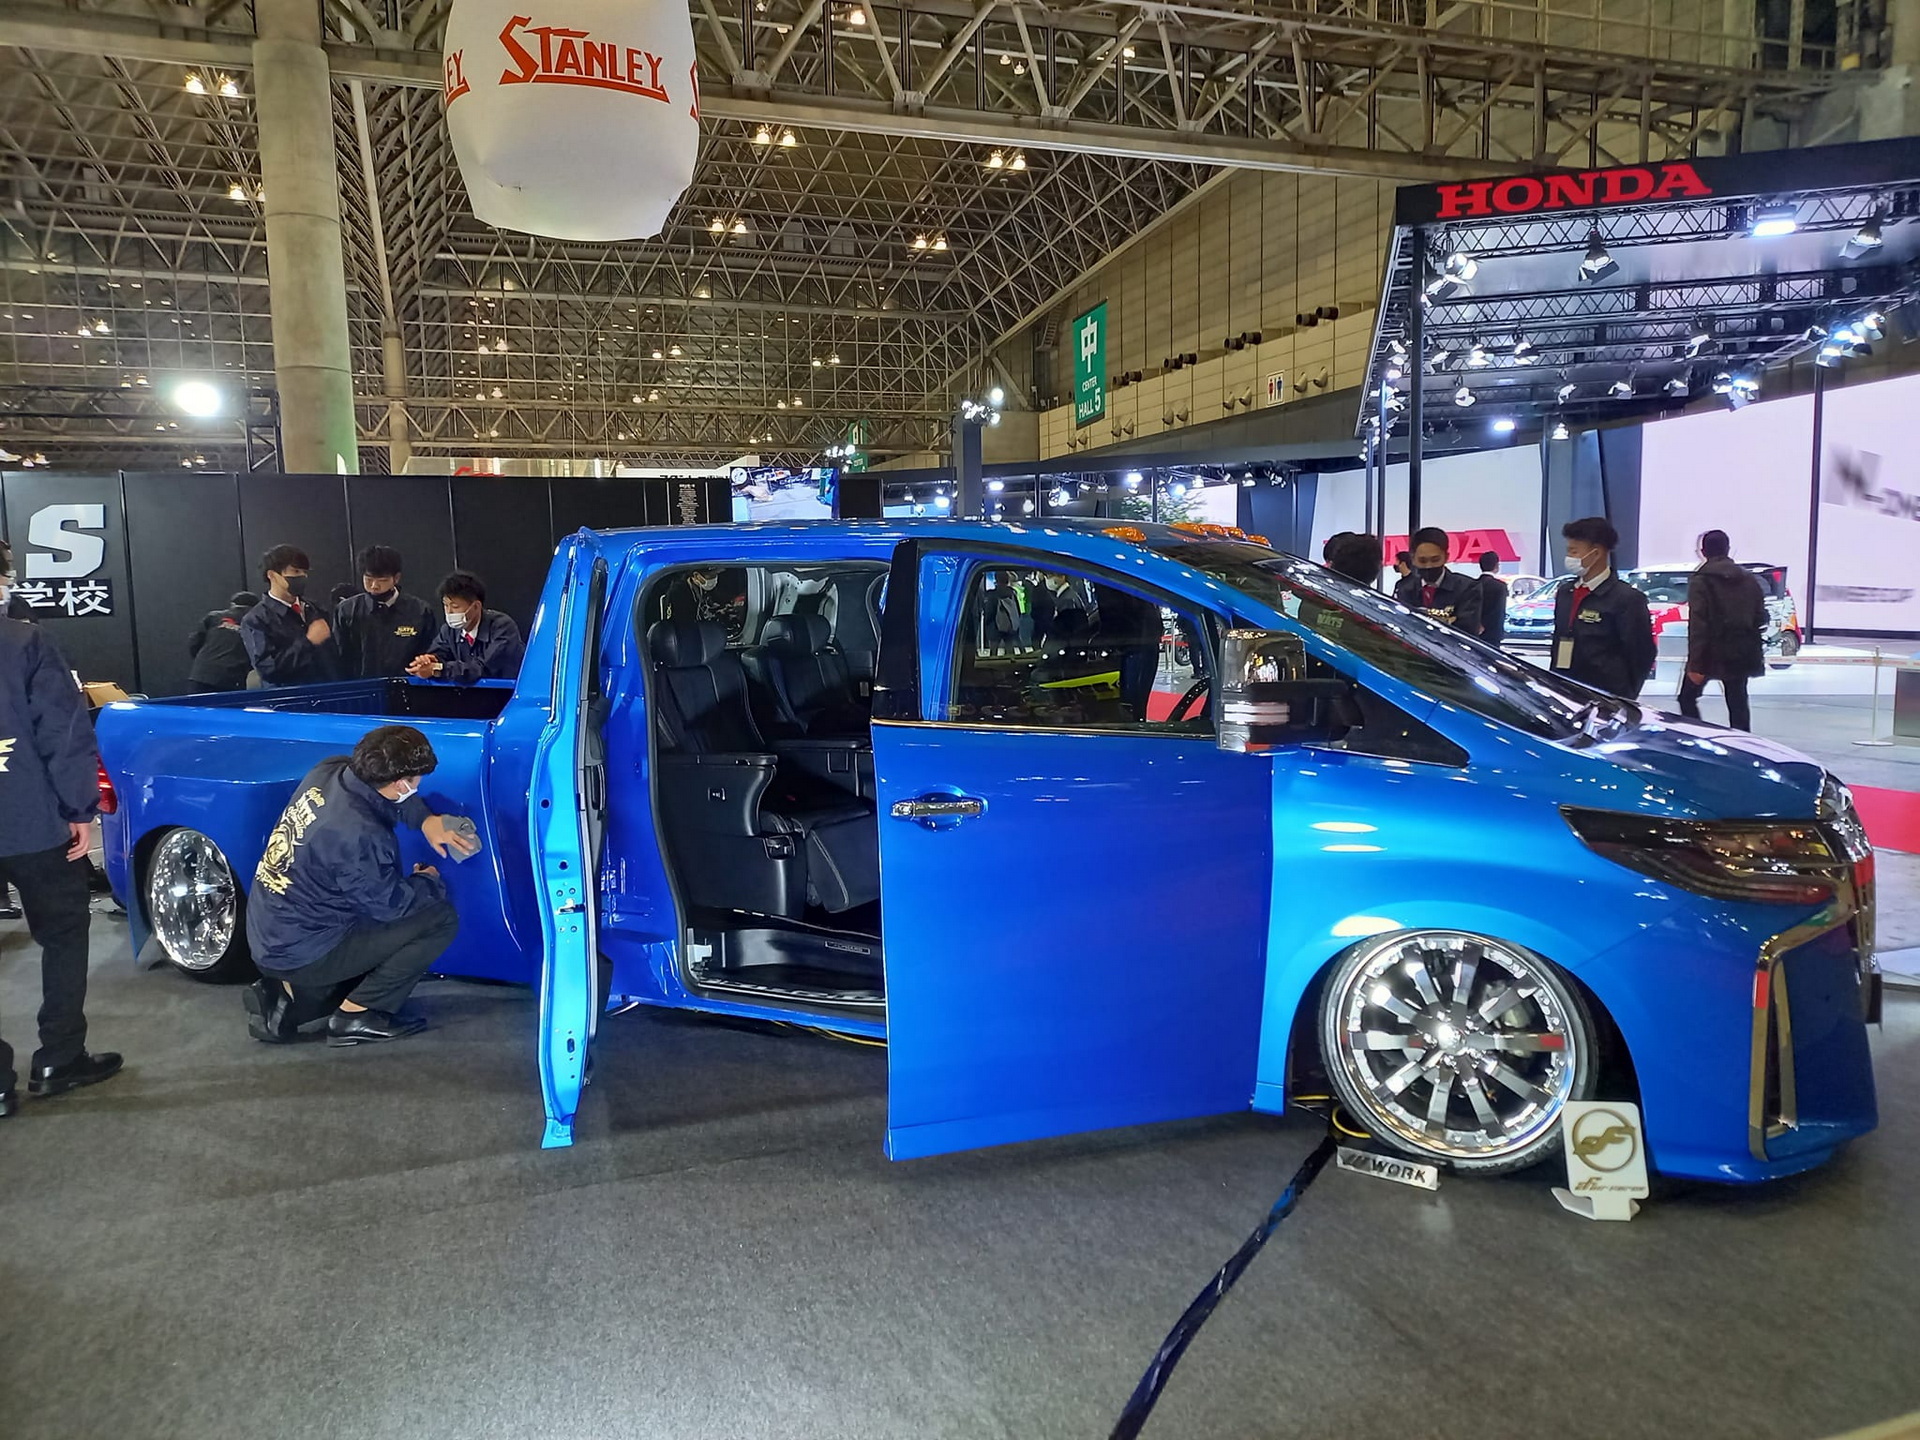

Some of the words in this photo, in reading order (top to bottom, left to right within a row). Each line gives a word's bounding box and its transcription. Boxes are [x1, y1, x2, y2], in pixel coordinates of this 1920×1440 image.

[499, 15, 669, 103] STANLEY
[1436, 164, 1712, 218] HONDA
[1081, 316, 1098, 373] 中
[1079, 399, 1094, 419] HALL
[1094, 387, 1101, 412] 5
[1081, 376, 1098, 392] CENTER
[26, 504, 105, 578] S
[9, 580, 112, 617] 学校
[1371, 1158, 1426, 1184] WORK
